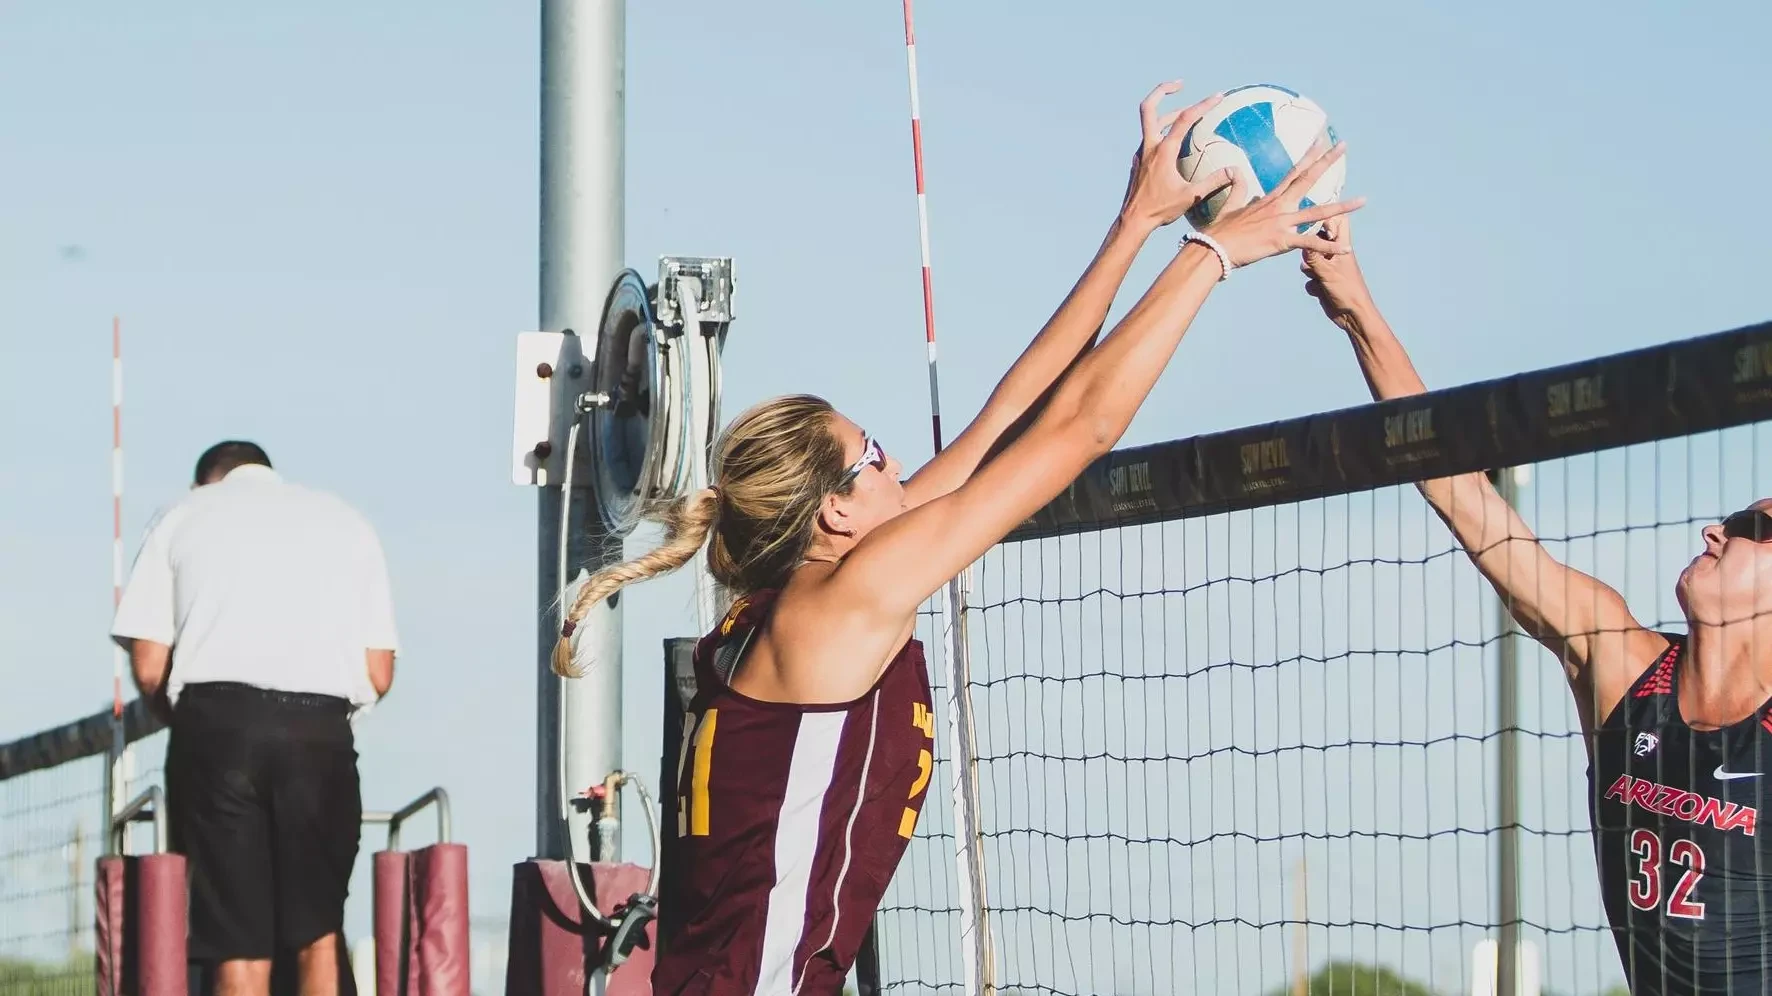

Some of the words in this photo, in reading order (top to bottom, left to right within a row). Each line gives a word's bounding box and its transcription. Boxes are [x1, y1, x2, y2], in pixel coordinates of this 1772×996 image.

[1109, 465, 1128, 496] SUN
[1129, 461, 1152, 493] DEVIL
[1604, 773, 1758, 837] ARIZONA
[1628, 828, 1706, 920] 32
